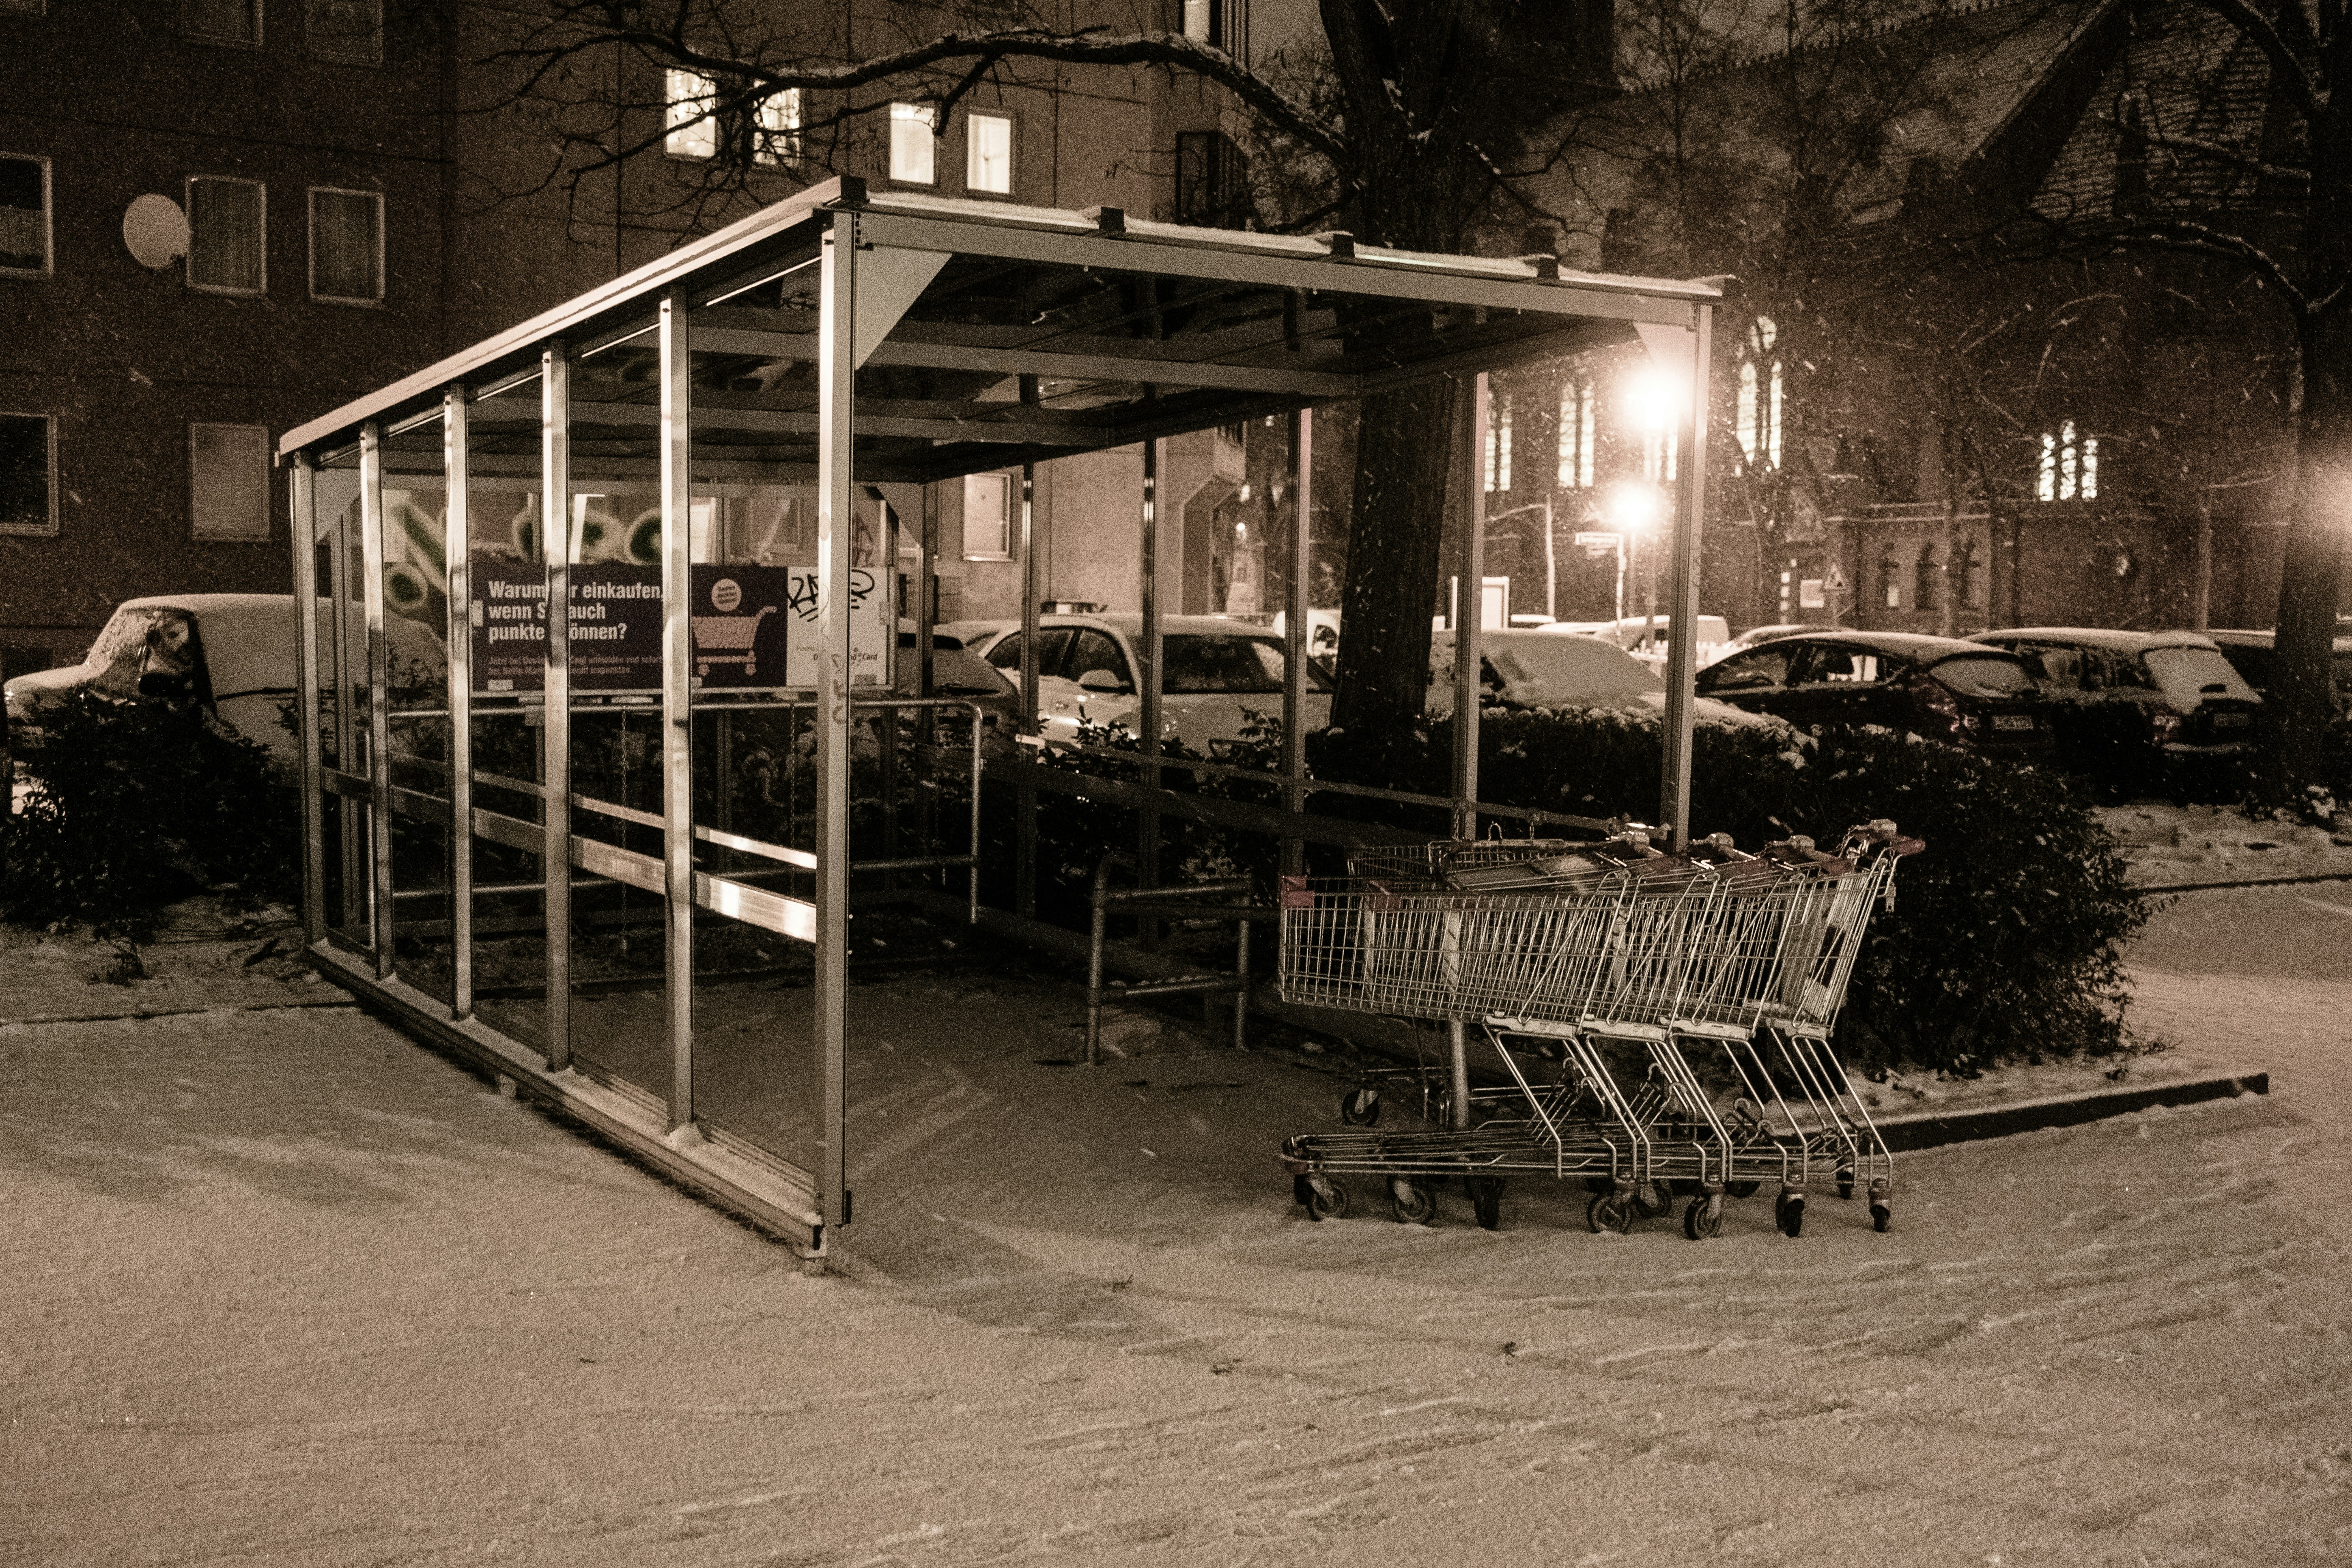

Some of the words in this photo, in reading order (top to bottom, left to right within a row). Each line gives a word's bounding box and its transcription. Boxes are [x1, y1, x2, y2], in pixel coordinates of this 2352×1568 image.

[488, 581, 546, 599] Warum
[488, 604, 532, 619] wenn
[569, 603, 605, 619] auch
[488, 624, 545, 643] punkte
[570, 623, 627, 640] önnen?
